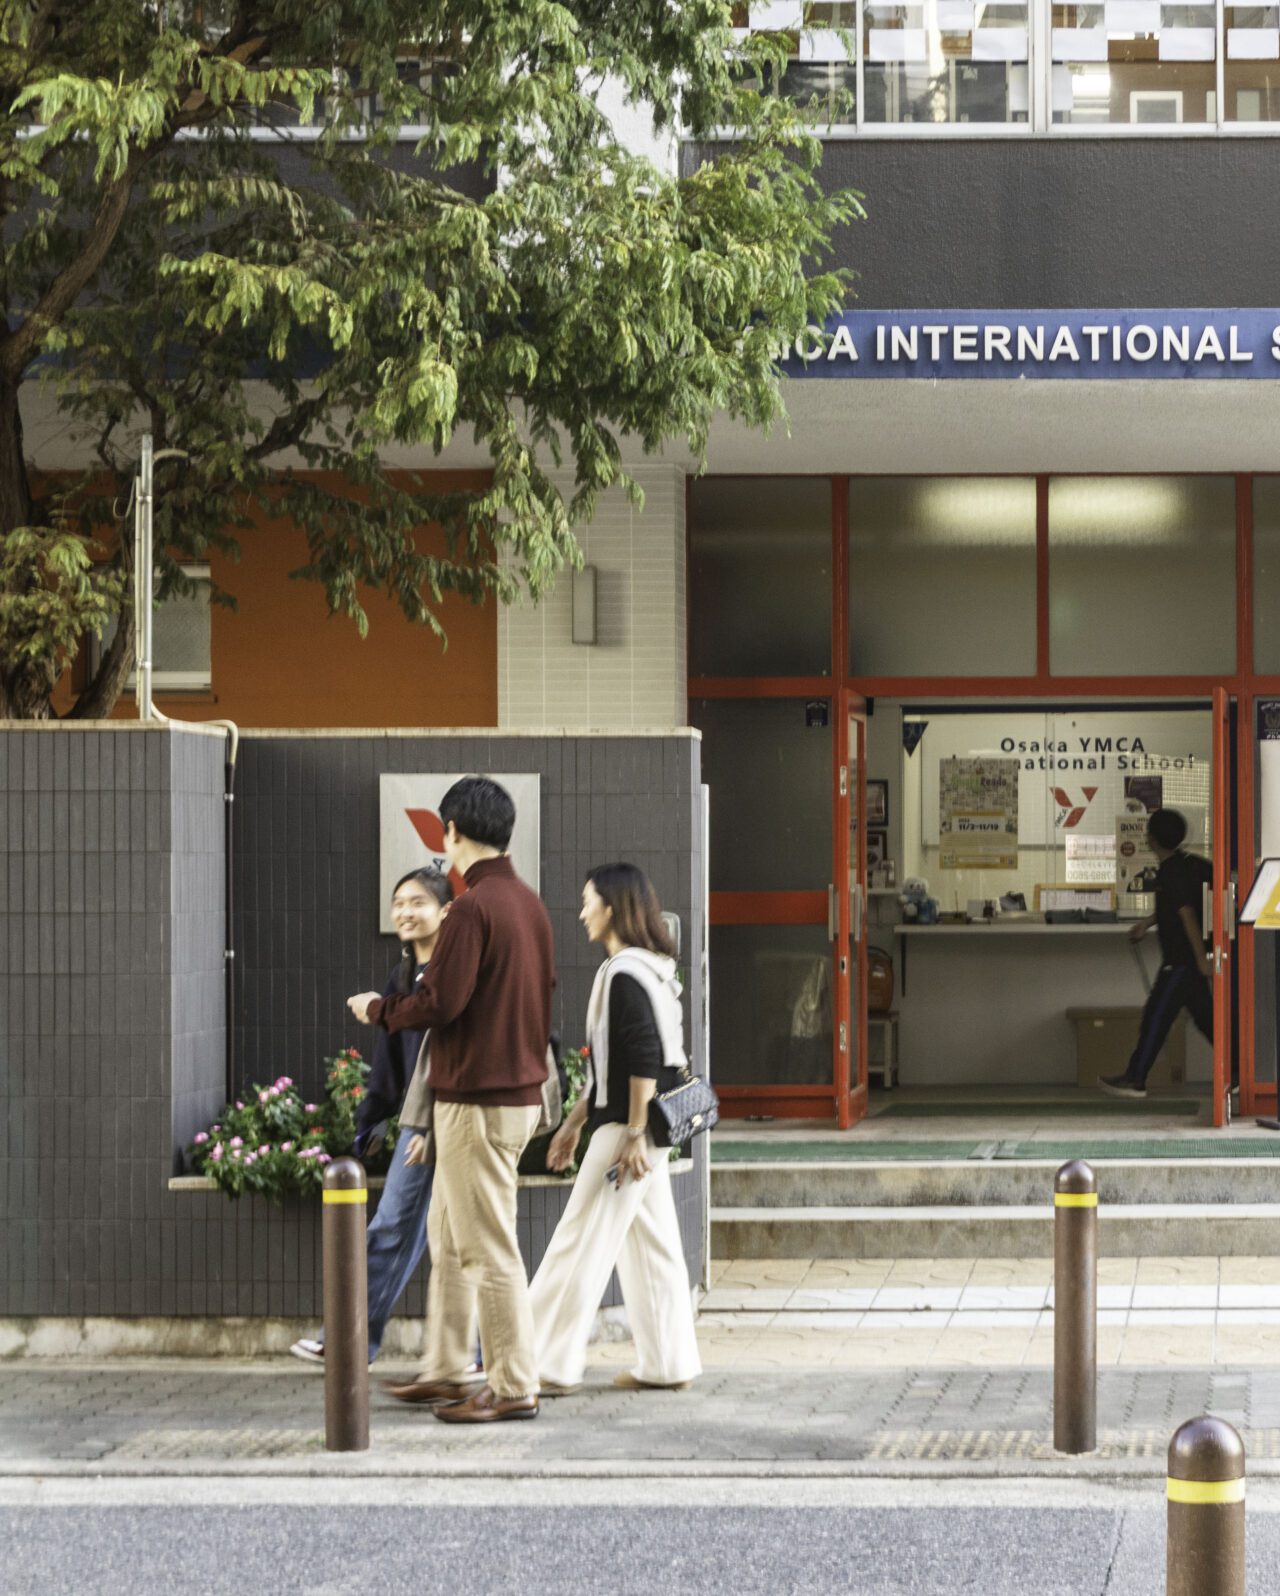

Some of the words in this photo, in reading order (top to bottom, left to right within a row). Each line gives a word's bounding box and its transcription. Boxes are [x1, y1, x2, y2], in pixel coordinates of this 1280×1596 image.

[875, 324, 1253, 361] INTERNATIONAL
[1000, 737, 1068, 753] Osaka
[1079, 737, 1145, 753] YMCA
[1117, 754, 1194, 770] School
